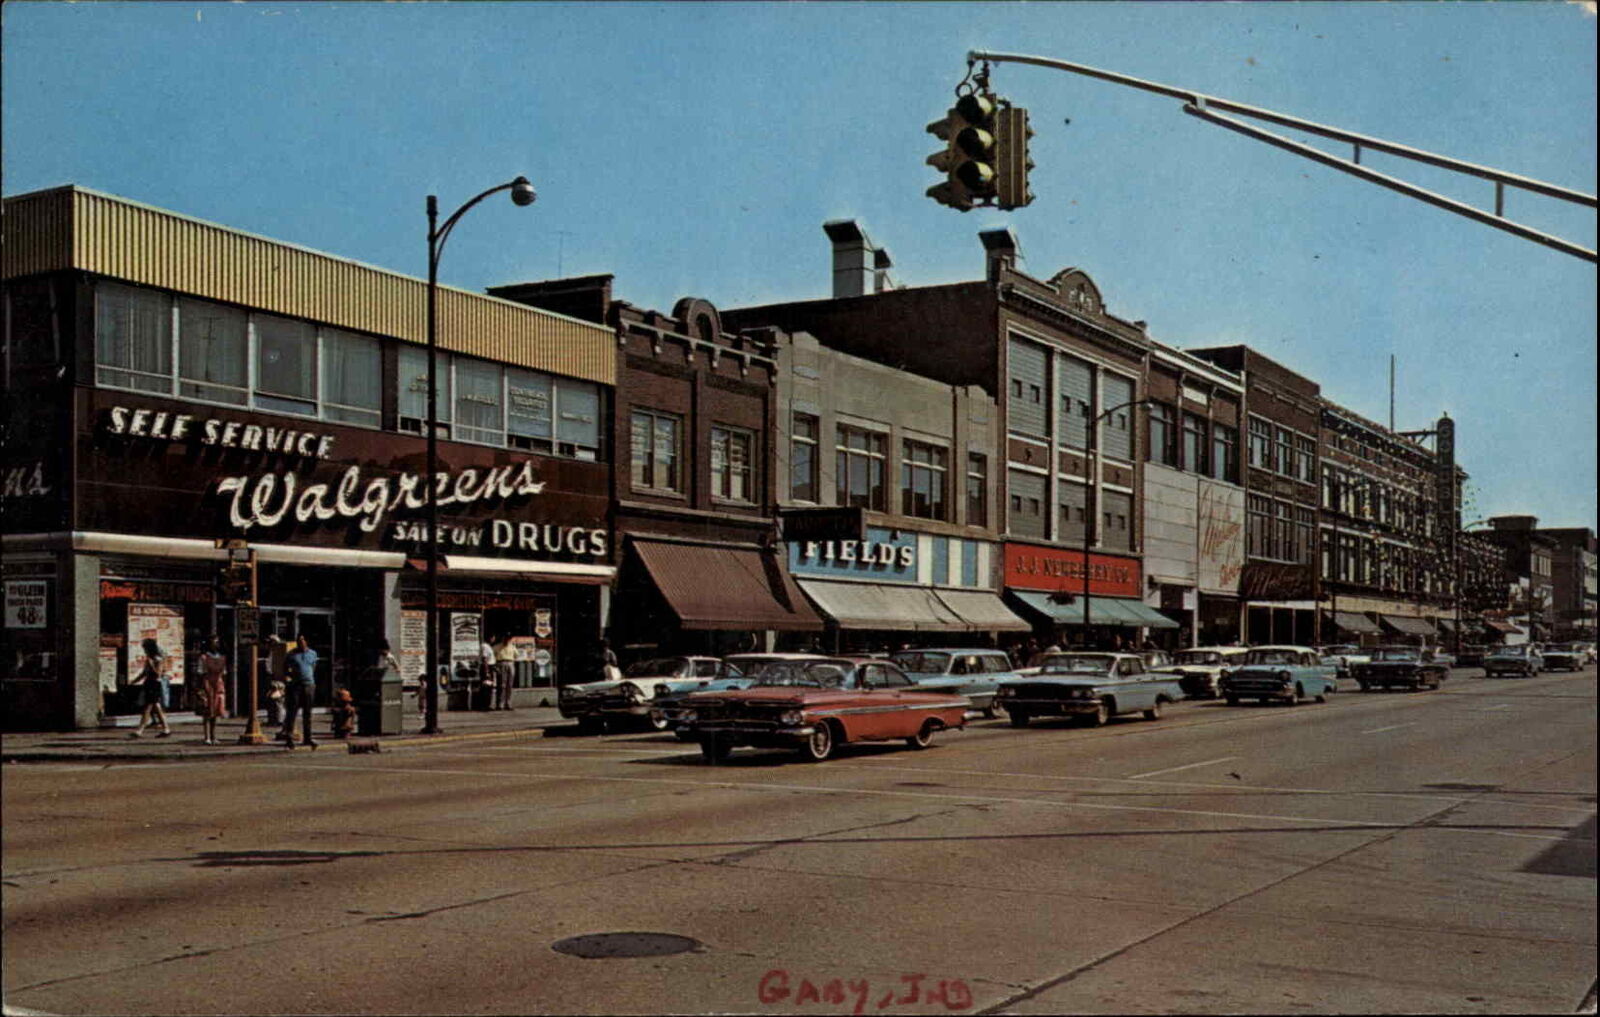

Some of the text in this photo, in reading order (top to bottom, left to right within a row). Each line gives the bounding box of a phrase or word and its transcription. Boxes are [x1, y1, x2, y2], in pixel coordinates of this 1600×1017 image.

[106, 406, 336, 460] SELF SERVICE
[217, 459, 546, 532] Walgreens
[451, 527, 484, 547] ON
[492, 519, 608, 556] DRUGS
[804, 539, 914, 567] FIELDS
